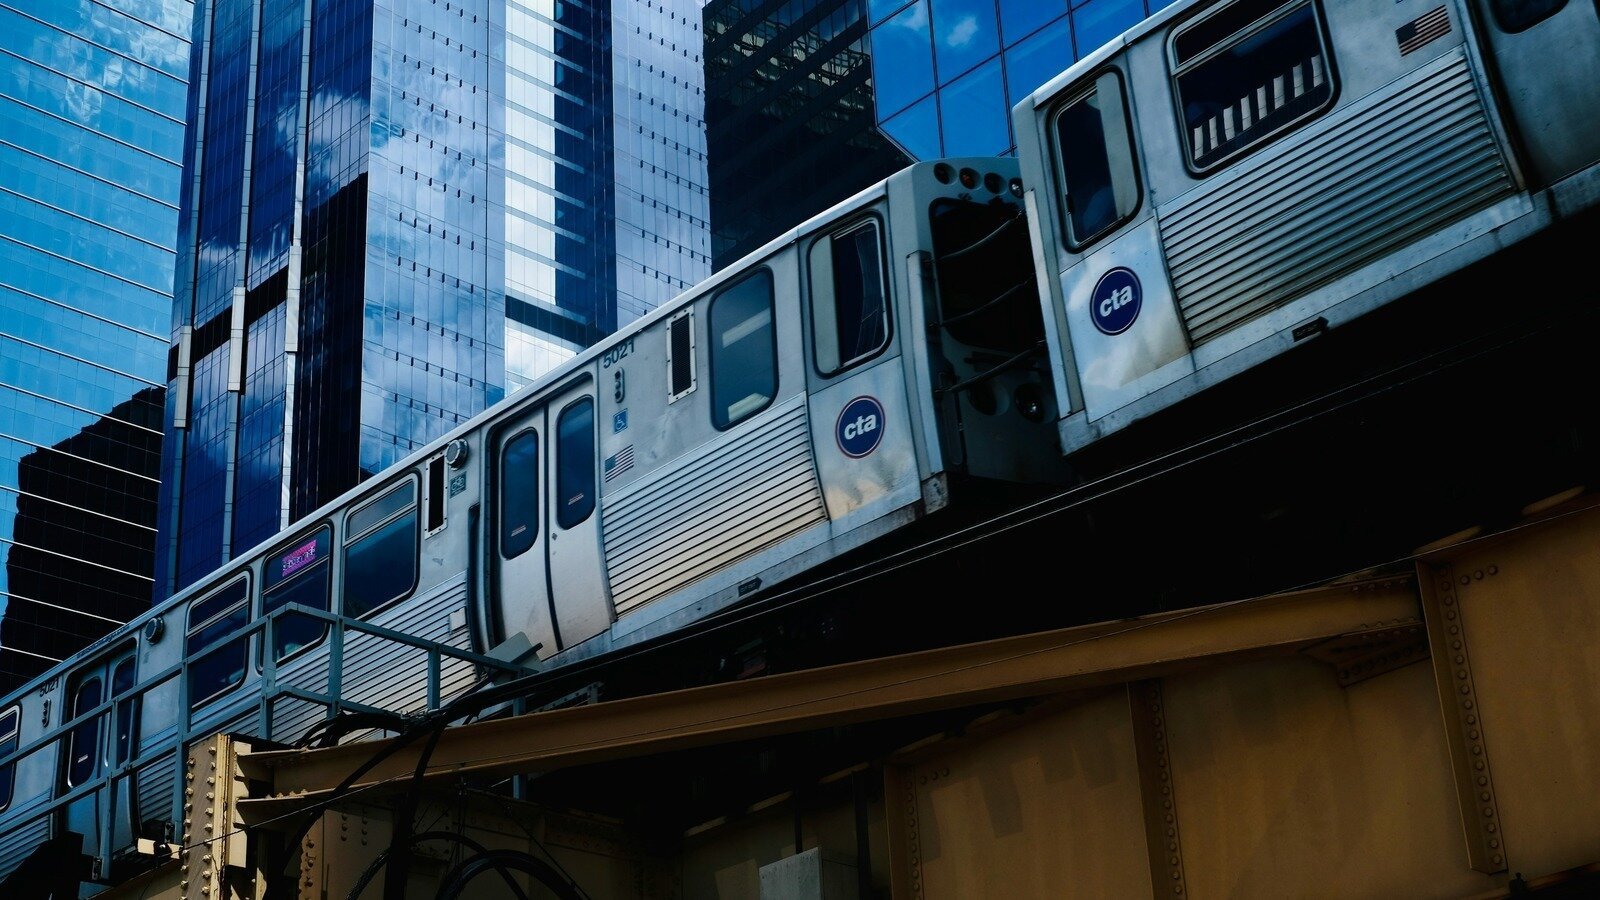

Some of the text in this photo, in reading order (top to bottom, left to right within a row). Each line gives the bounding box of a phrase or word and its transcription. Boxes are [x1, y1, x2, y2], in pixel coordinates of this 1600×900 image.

[1100, 285, 1133, 317] cta
[603, 339, 635, 369] 5021
[844, 414, 877, 440] cta
